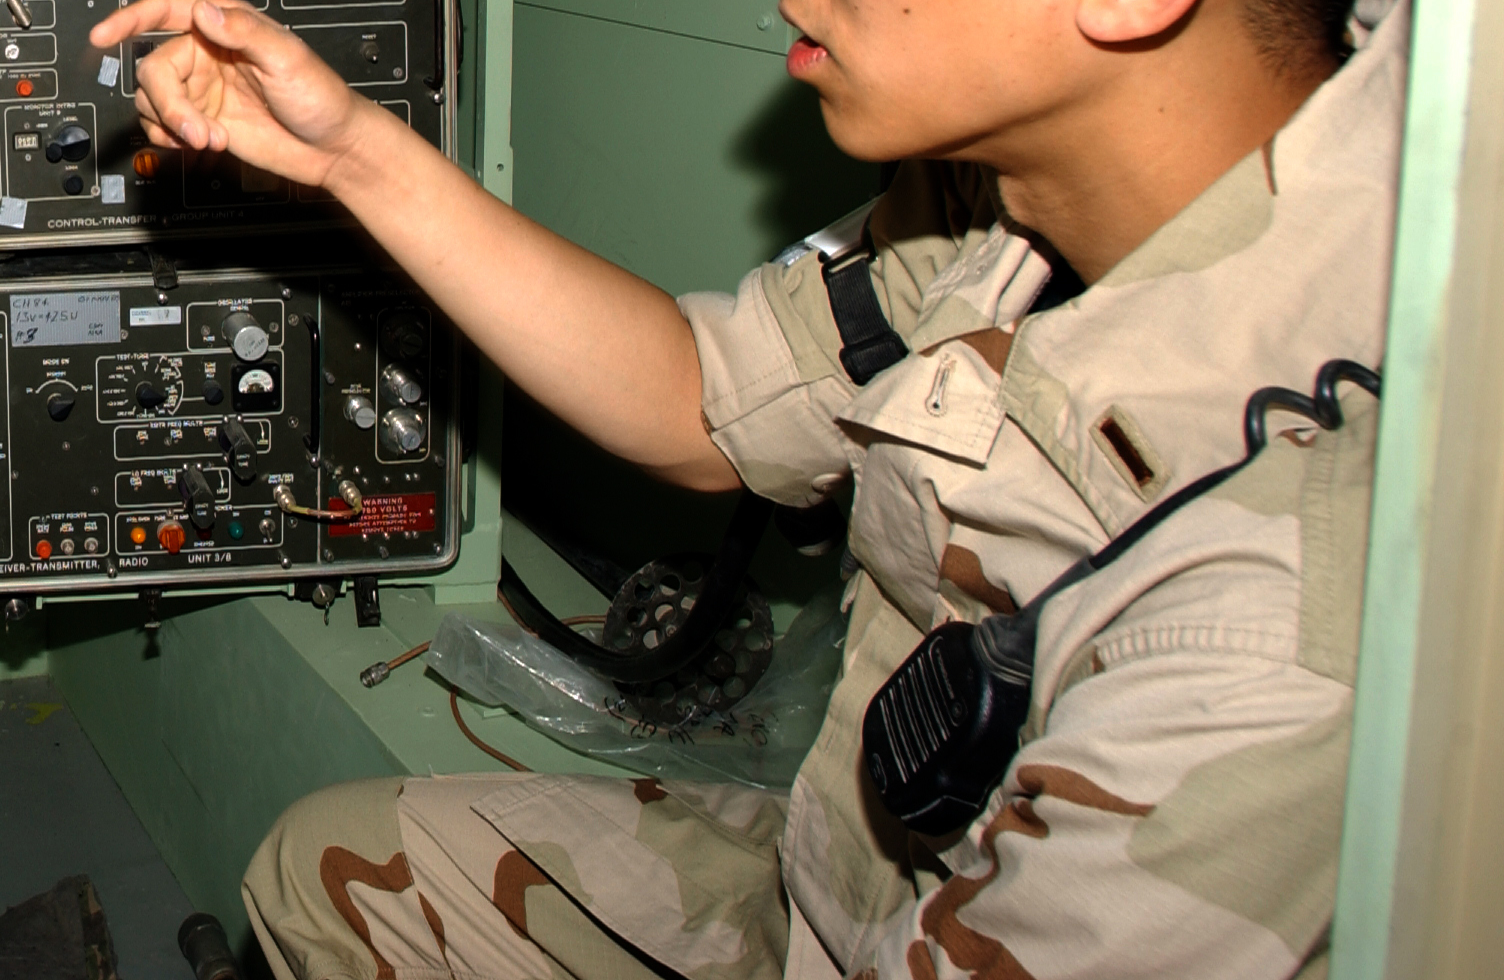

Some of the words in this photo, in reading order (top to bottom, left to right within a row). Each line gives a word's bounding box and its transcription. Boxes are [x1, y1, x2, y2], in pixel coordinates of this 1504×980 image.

[47, 214, 157, 229] CONTROL-TRANSFER
[171, 211, 208, 222] GROUP
[211, 210, 235, 220] UNIT
[363, 496, 403, 505] WARNING
[380, 505, 408, 513] VOLTS
[119, 555, 149, 567] RADIO
[187, 554, 211, 564] UNIT
